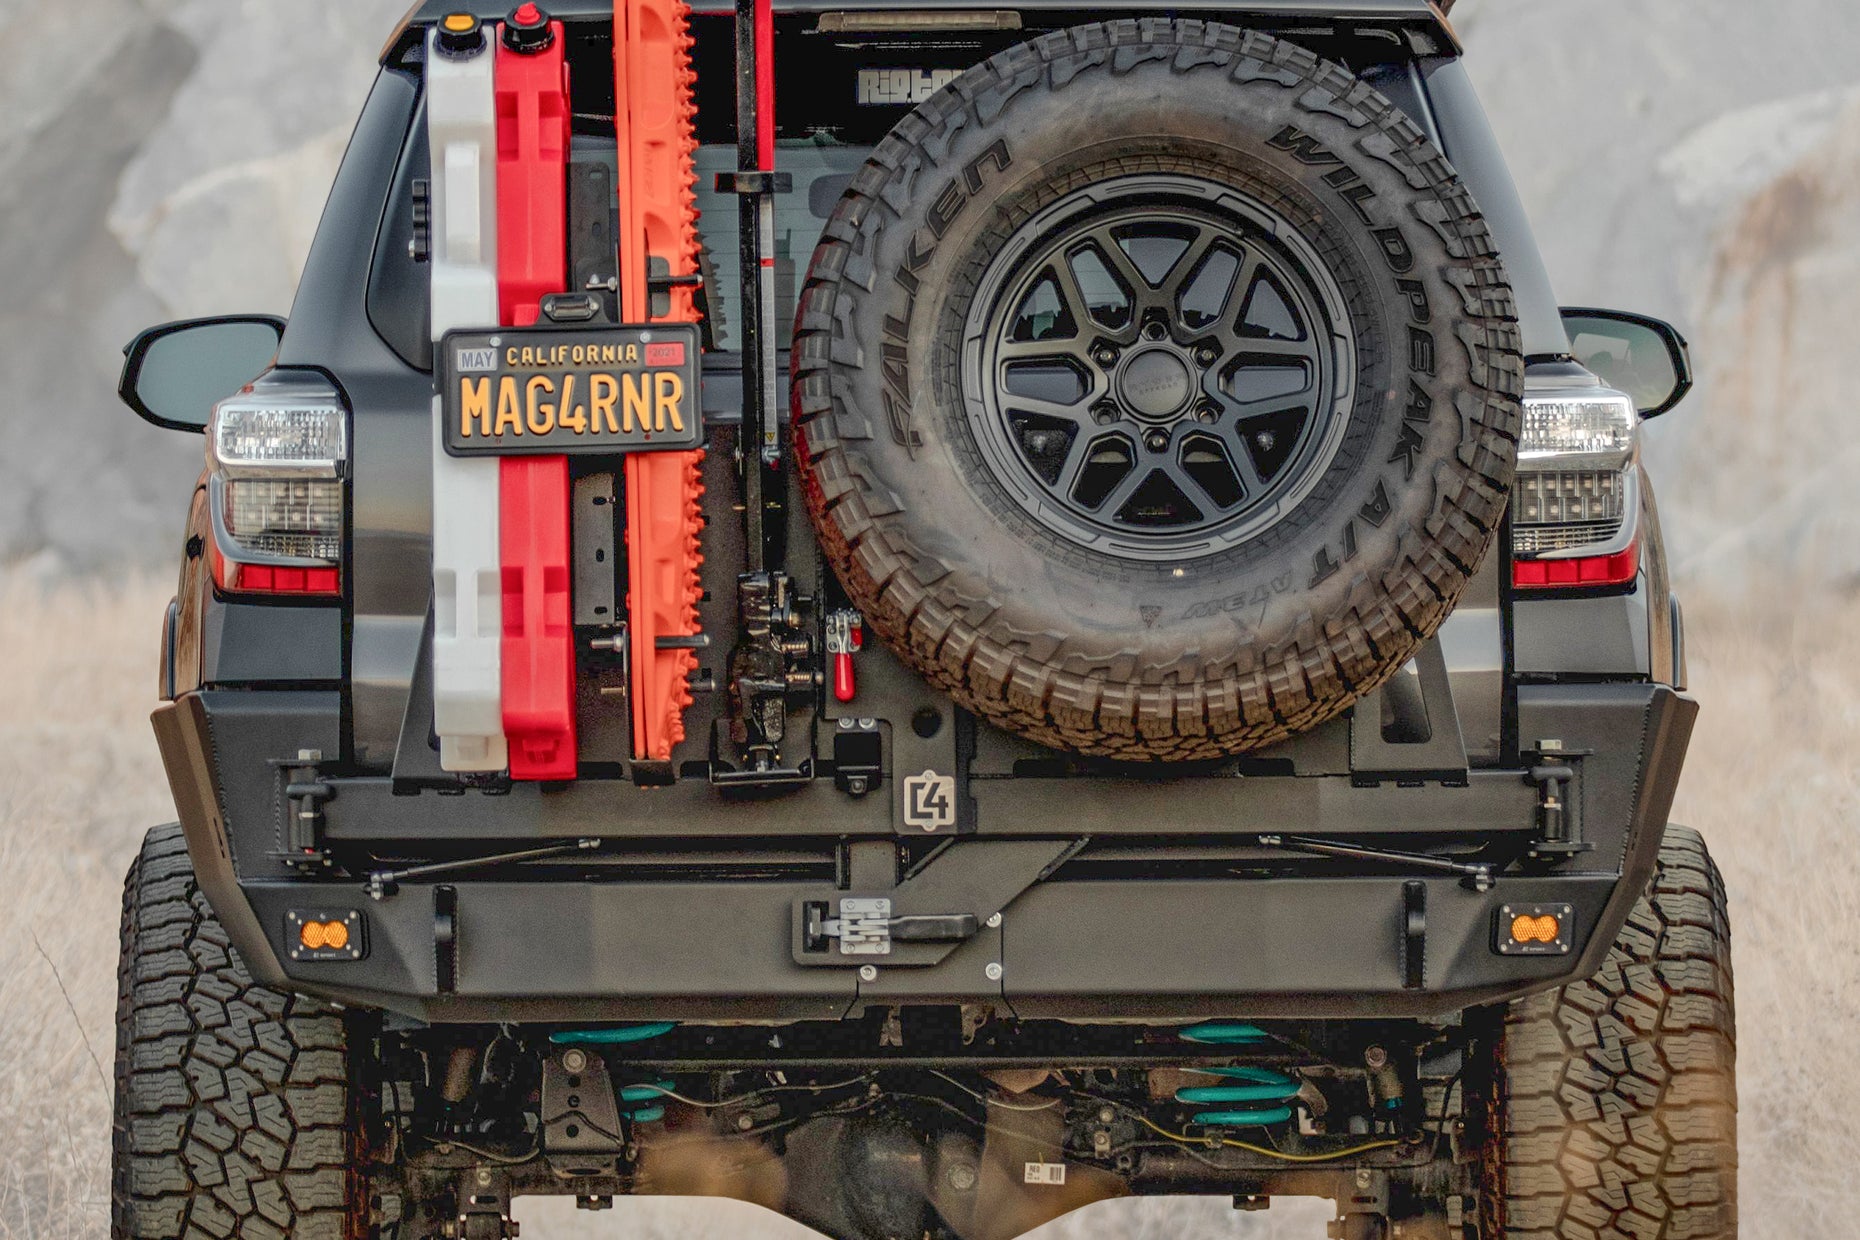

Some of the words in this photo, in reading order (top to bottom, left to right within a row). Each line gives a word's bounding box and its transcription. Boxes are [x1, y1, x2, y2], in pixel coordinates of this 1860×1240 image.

[878, 137, 1013, 461] FALKEN
[1264, 124, 1438, 482] WILDPEAK
[461, 350, 493, 368] MAY
[506, 343, 638, 366] CALIFORNIA
[460, 371, 685, 437] MAG4RNR
[909, 781, 949, 819] C4
